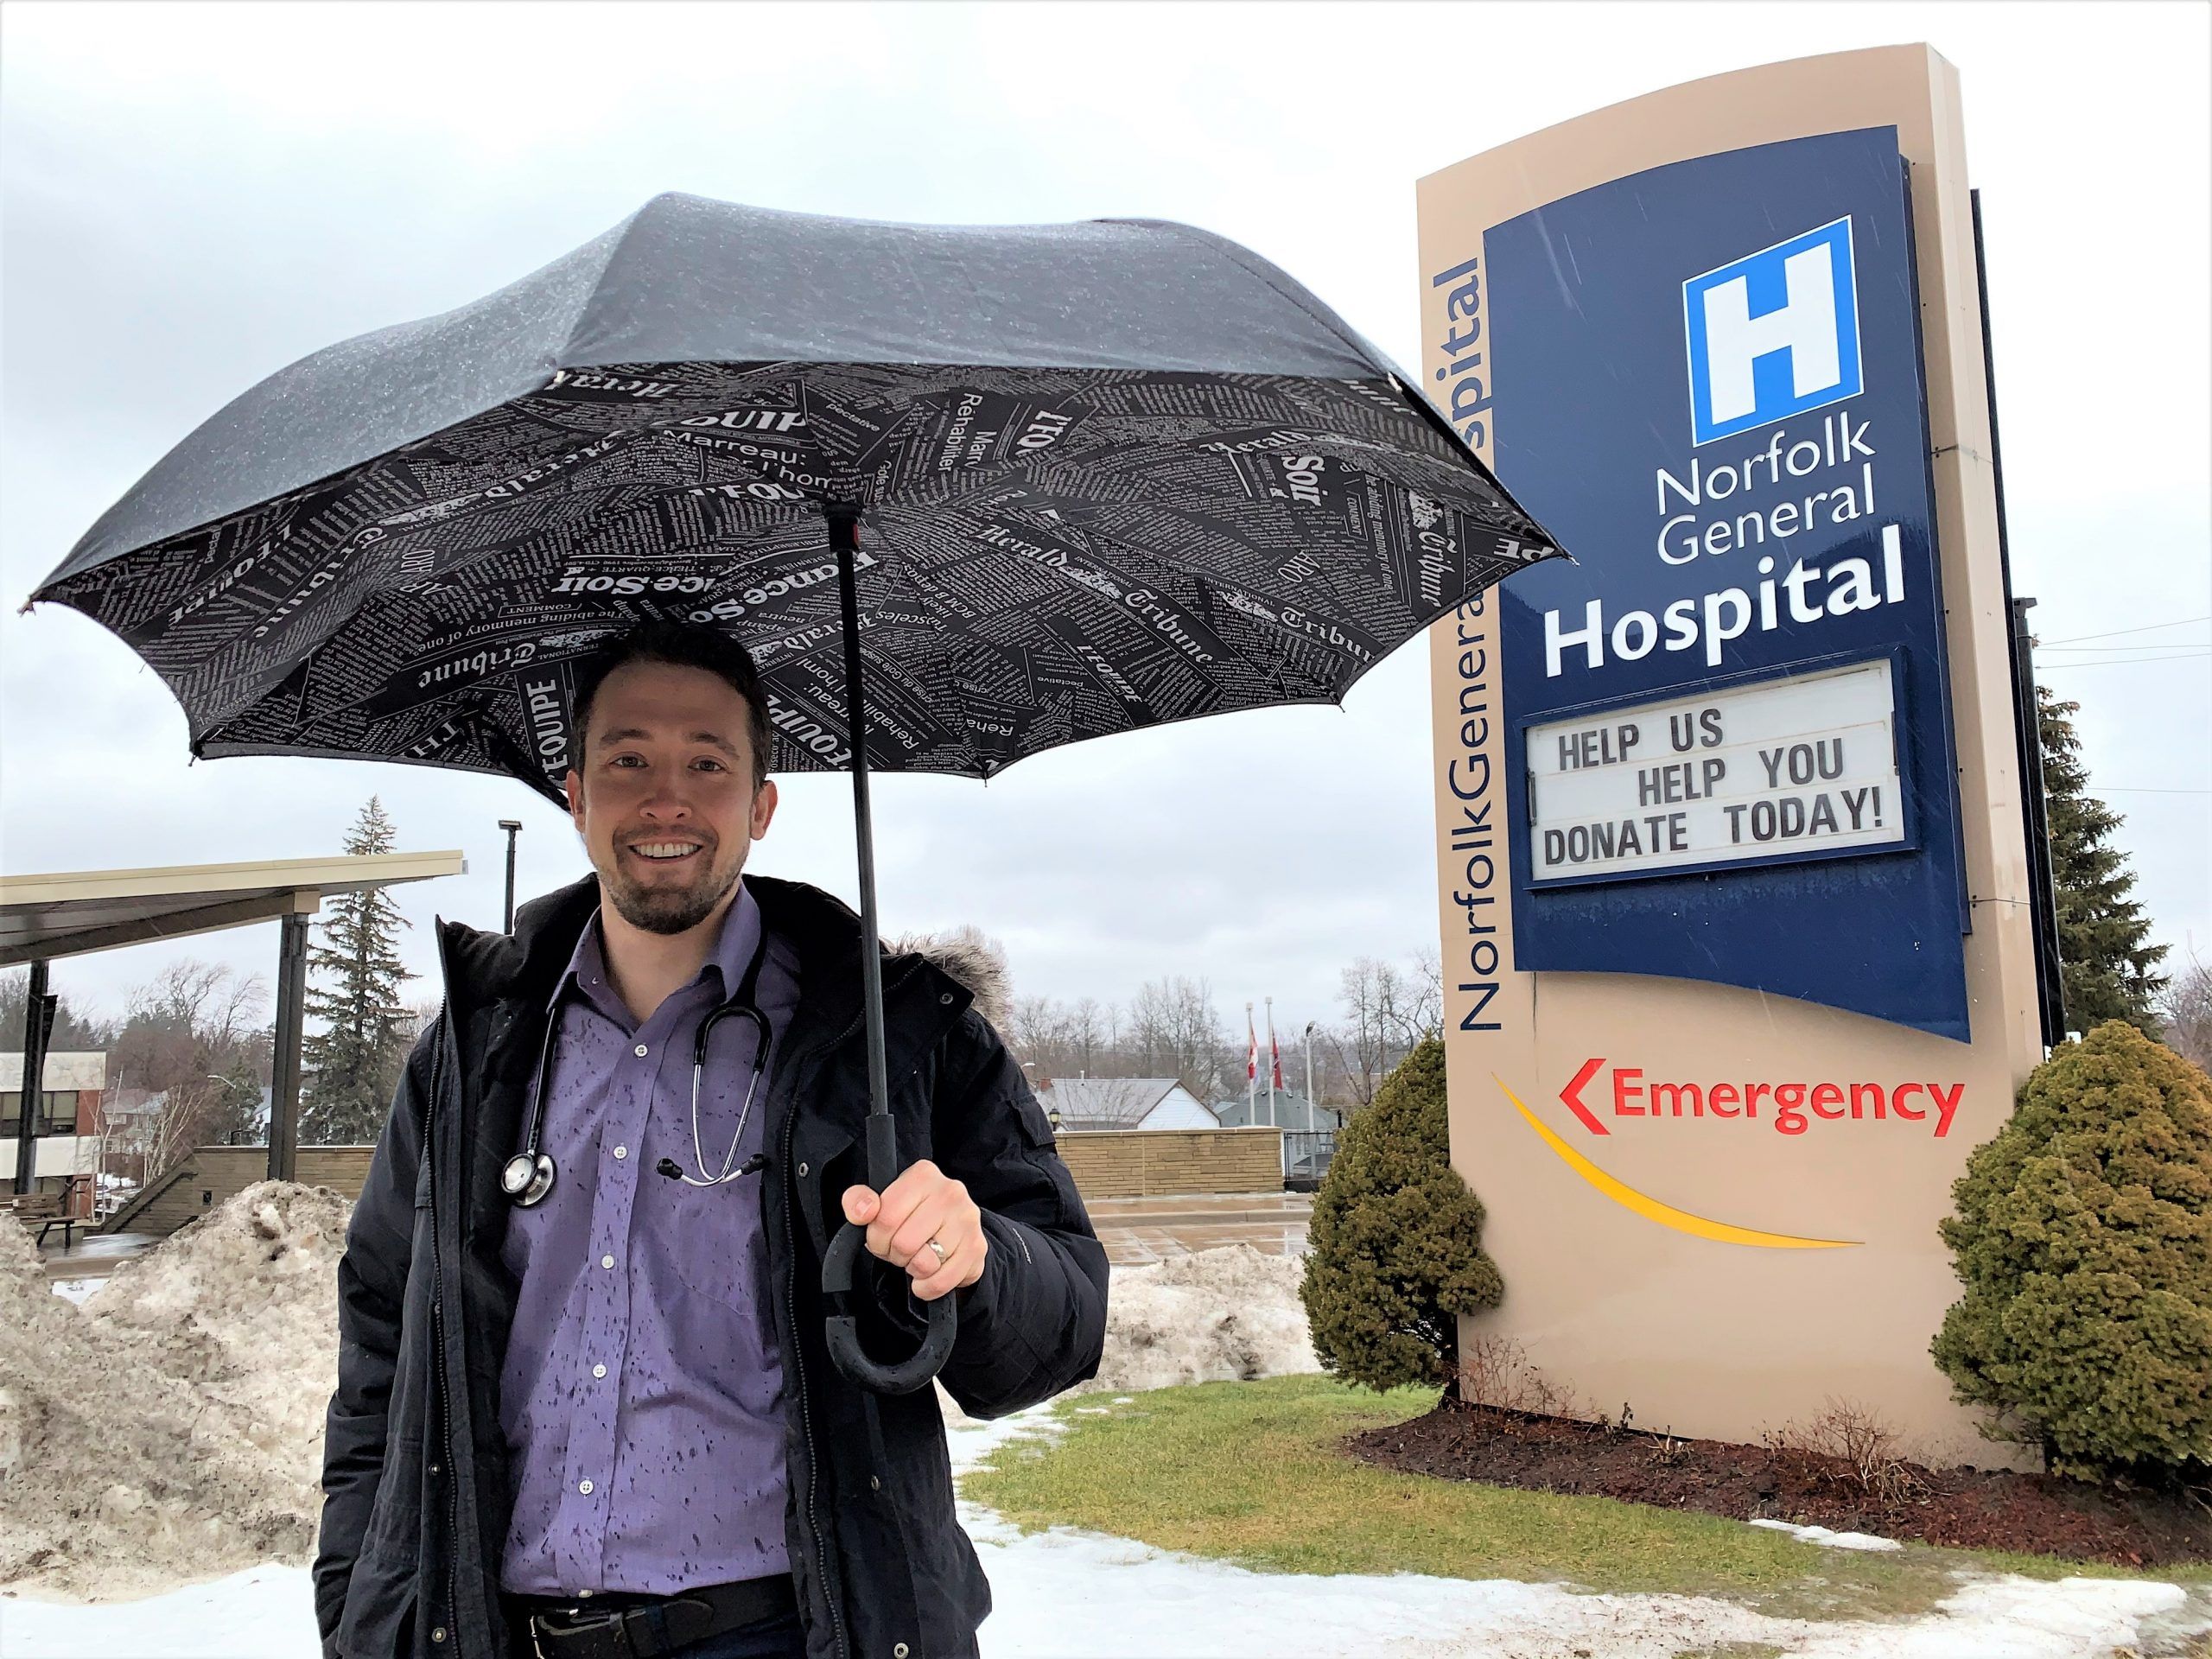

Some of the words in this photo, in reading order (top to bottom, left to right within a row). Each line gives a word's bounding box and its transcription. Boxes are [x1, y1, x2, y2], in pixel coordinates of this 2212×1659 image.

[1656, 411, 1876, 515] Norfolk
[1657, 462, 1875, 565] General
[1124, 588, 1215, 664] Tribune
[1545, 524, 1905, 677] Hospital
[418, 642, 536, 689] Tribune
[1559, 723, 1639, 771] HELP
[1671, 709, 1723, 752] US
[1638, 758, 1726, 806] HELP
[1758, 738, 1843, 788] YOU
[1545, 811, 1688, 865] DONATE
[1724, 785, 1883, 843] TODAY!
[1613, 1068, 1965, 1137] Emergency
